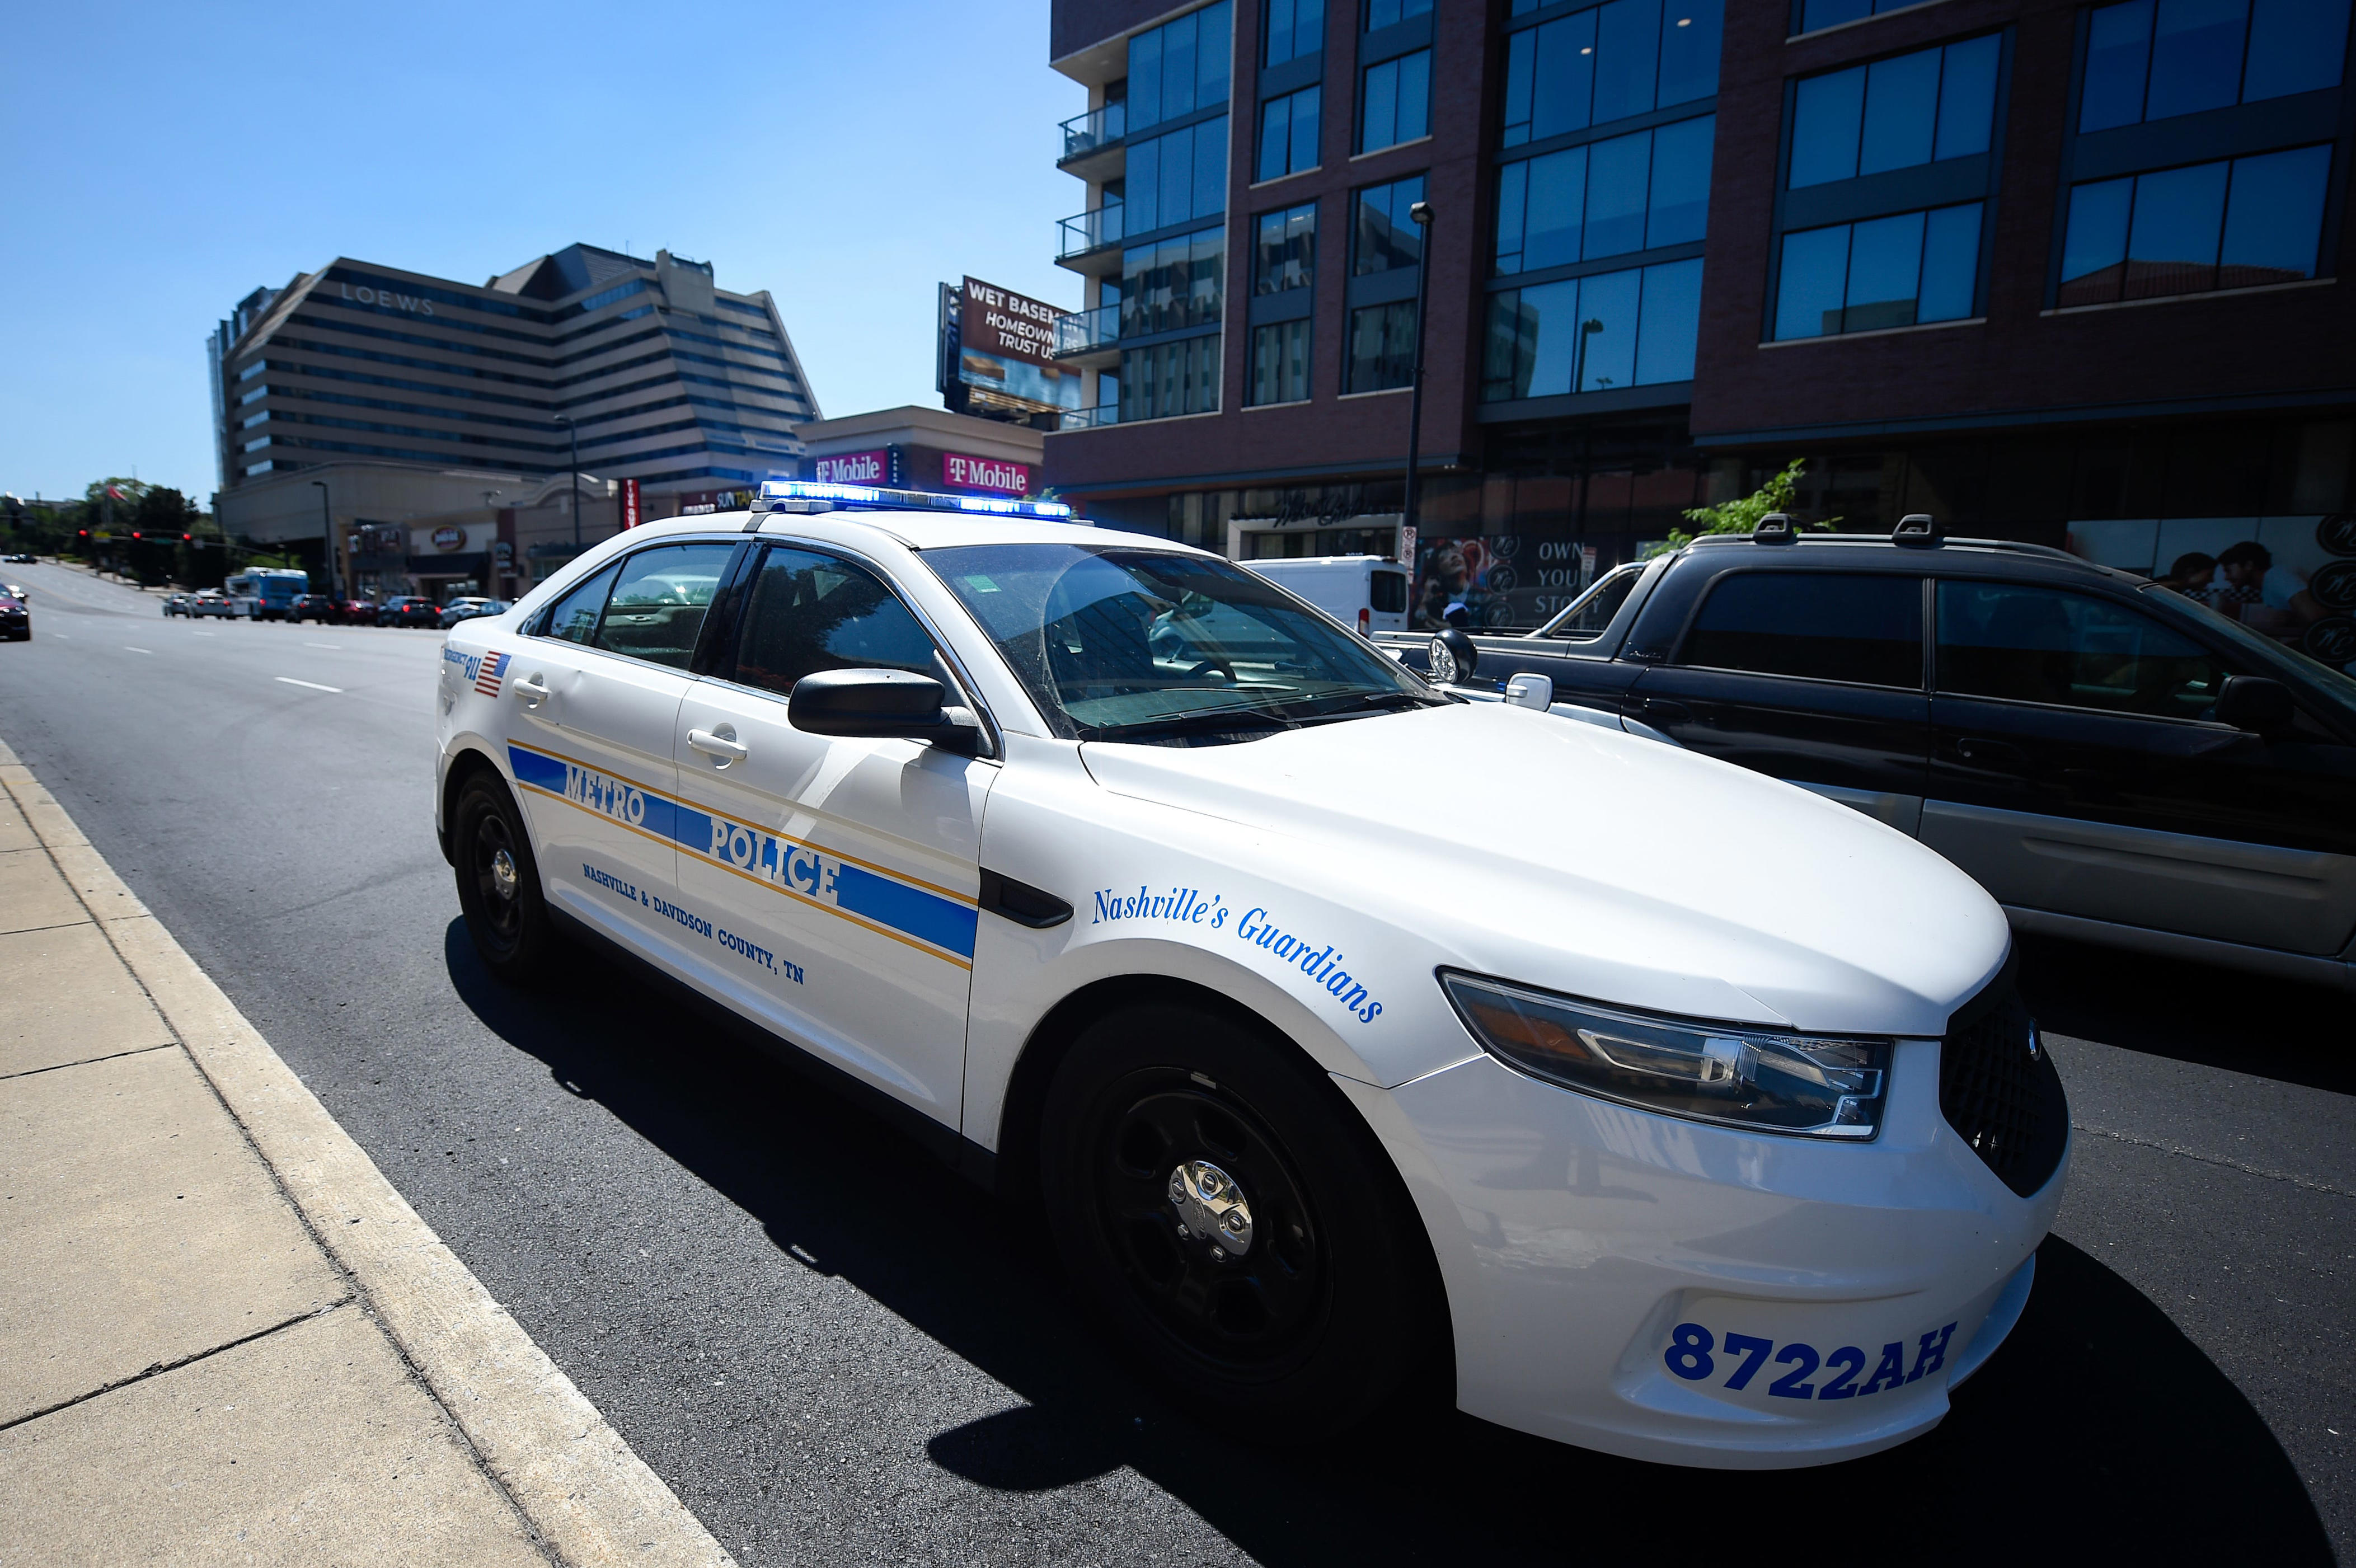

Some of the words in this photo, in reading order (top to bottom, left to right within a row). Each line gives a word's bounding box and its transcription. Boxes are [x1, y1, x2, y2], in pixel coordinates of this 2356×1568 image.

[341, 281, 435, 316] LOEWS
[968, 281, 1005, 307] WET
[999, 332, 1039, 355] TRUST
[1539, 542, 1584, 560] OWN
[1534, 595, 1603, 614] STOY
[463, 655, 481, 681] 911
[564, 765, 645, 825] METRO
[710, 818, 841, 905] POLICE
[583, 863, 637, 902] NASHVILLE
[640, 890, 649, 908] &
[653, 896, 712, 940] DAVIDSON
[717, 928, 778, 975] COUNTY,
[783, 959, 805, 986] TN
[1092, 885, 1229, 929] Nashville's
[1237, 907, 1384, 1024] Guardians
[1664, 1321, 1959, 1401] 8722AH
